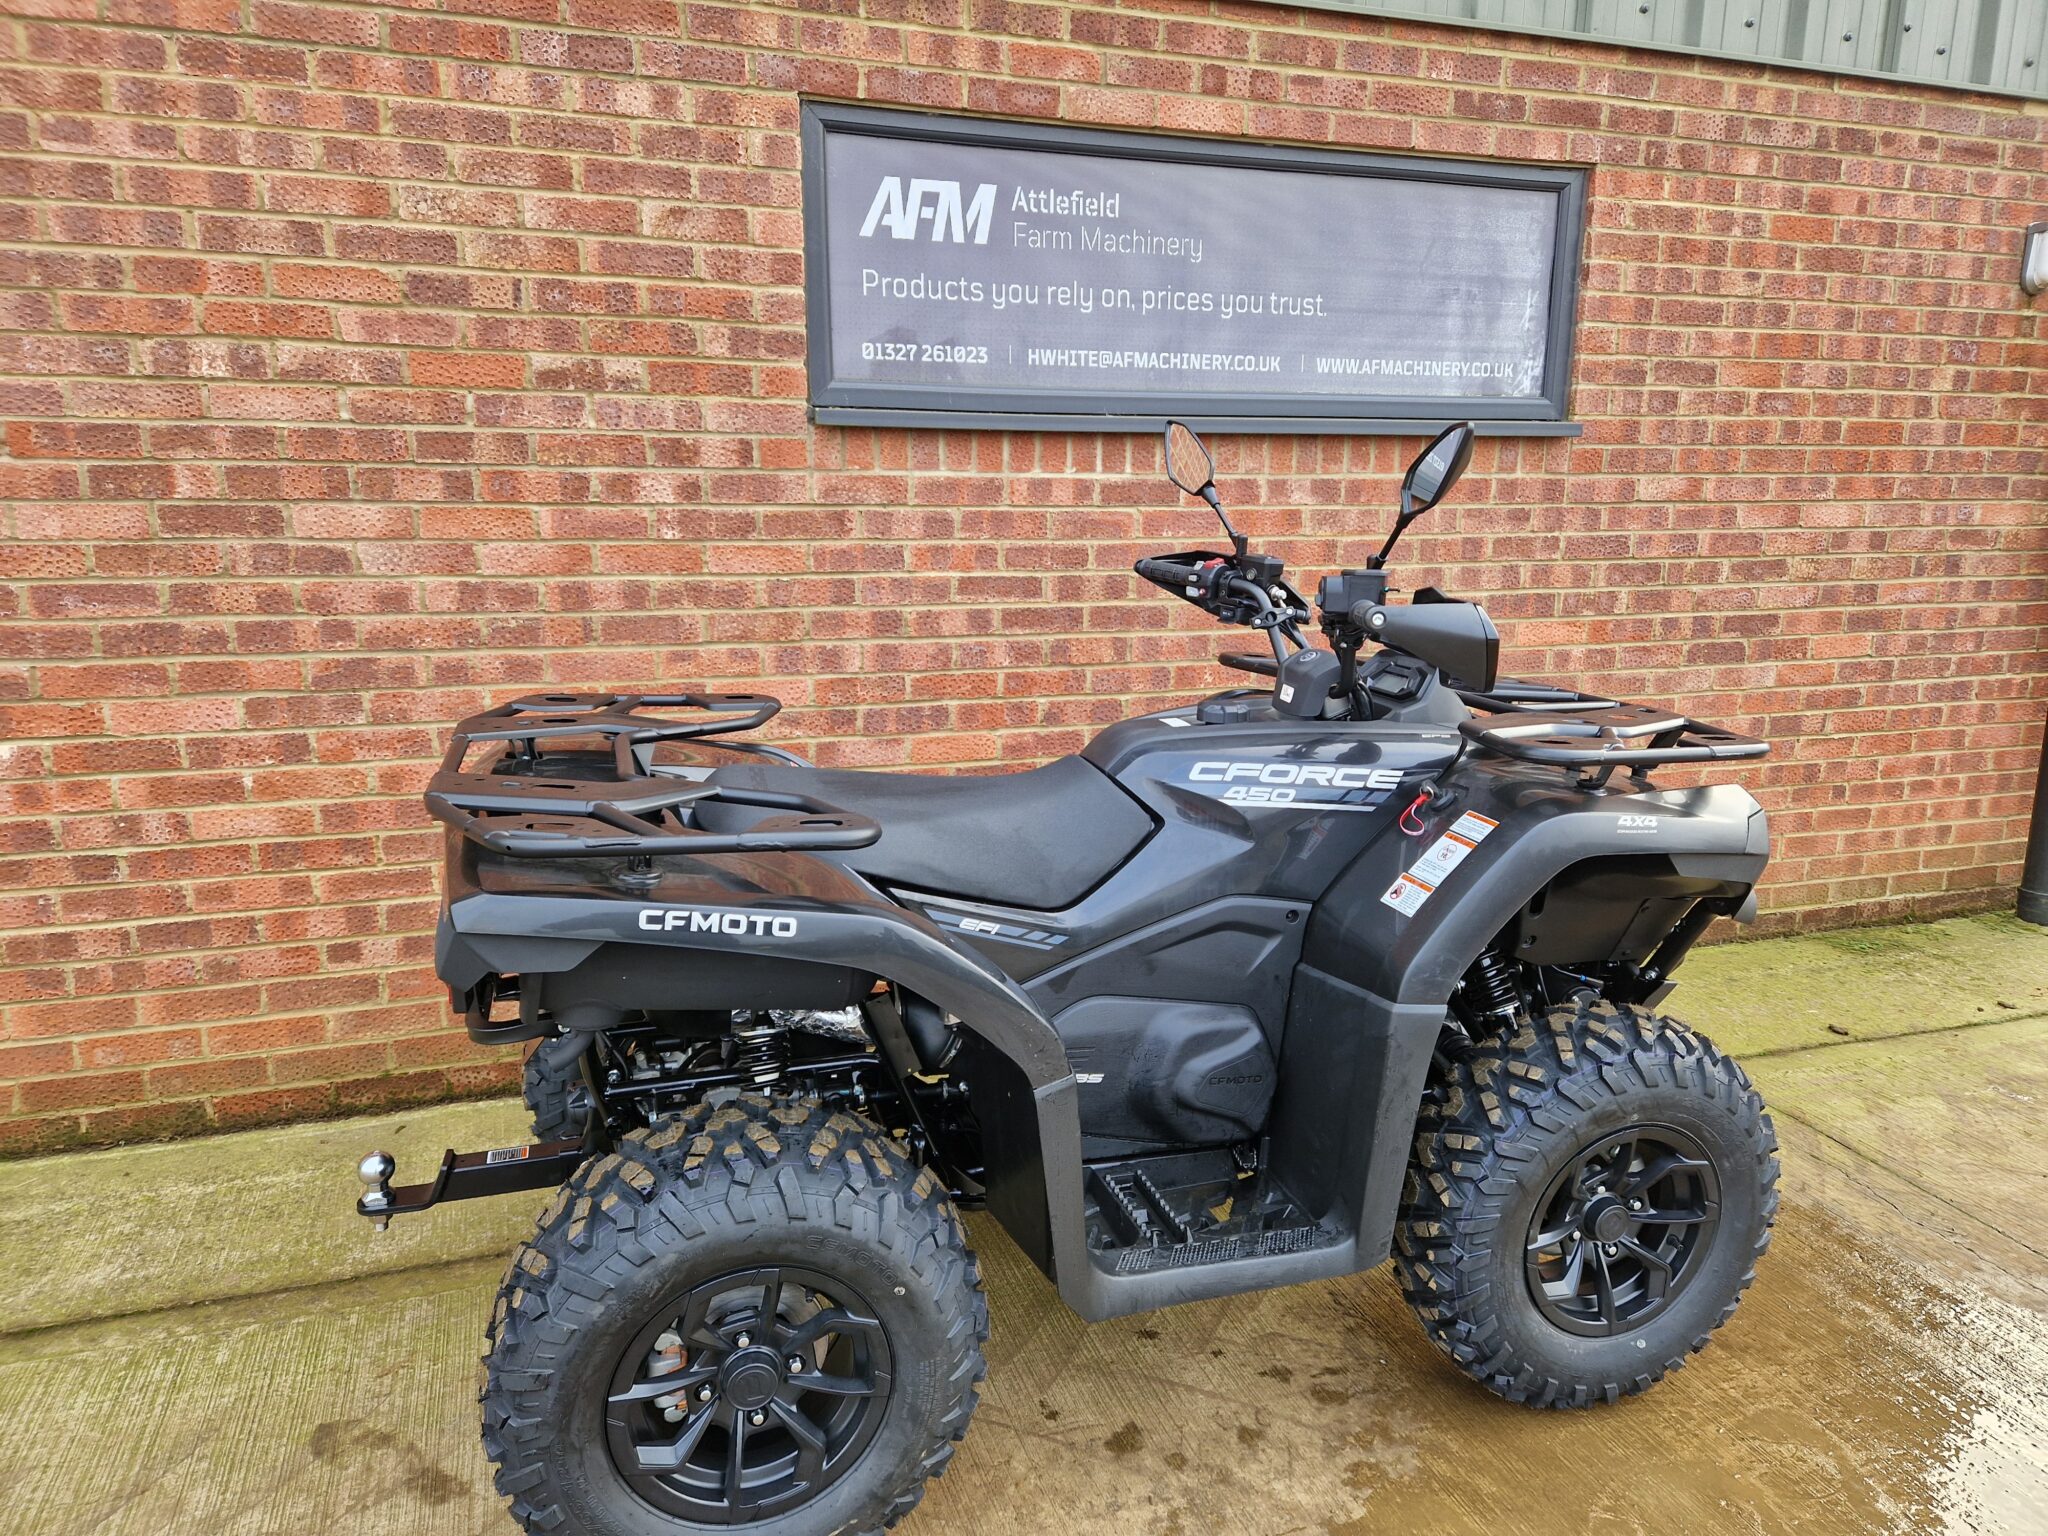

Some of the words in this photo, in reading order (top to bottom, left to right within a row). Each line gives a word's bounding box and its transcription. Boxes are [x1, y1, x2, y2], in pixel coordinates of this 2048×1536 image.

[859, 175, 998, 245] AFM
[1011, 185, 1120, 218] Attlefield
[1013, 221, 1072, 250] Farm
[1080, 225, 1203, 263] Machinery
[861, 268, 984, 302] Products
[992, 282, 1039, 309] you
[1047, 280, 1093, 313] rely
[1101, 287, 1135, 311] on,
[1142, 284, 1214, 316] prices
[1221, 293, 1263, 319] you
[1270, 292, 1327, 317] trust.
[861, 342, 916, 361] 01327
[921, 345, 989, 364] 261023
[1028, 348, 1281, 373] HWHITE@AFMACHINERY.CO.UK
[1316, 357, 1514, 378] WWW.AFMACHINERY.CO.UK
[1188, 761, 1405, 789] CFORCE
[1223, 786, 1297, 802] 450
[638, 909, 798, 938] CFMOTO
[958, 917, 1001, 935] EFI
[1208, 1074, 1263, 1086] CFMOTO
[806, 1235, 898, 1286] CFMOTO
